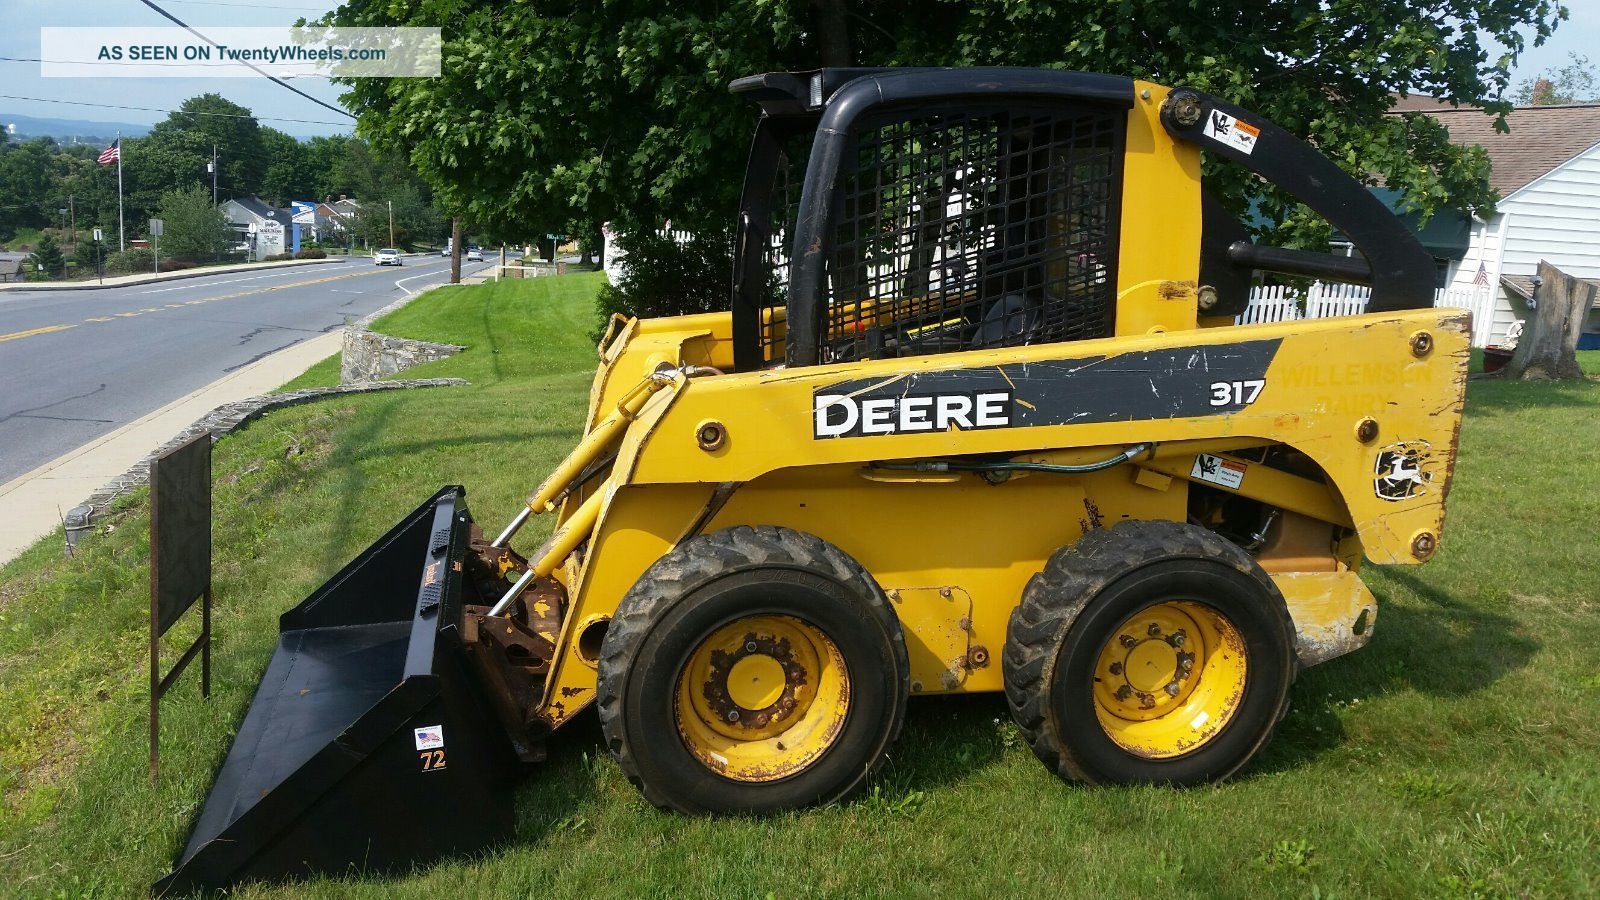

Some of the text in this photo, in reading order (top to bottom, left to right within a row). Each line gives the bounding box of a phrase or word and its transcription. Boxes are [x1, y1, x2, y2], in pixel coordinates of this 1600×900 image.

[1210, 380, 1265, 406] 317
[816, 393, 1009, 436] DEERE
[420, 750, 446, 770] 72
